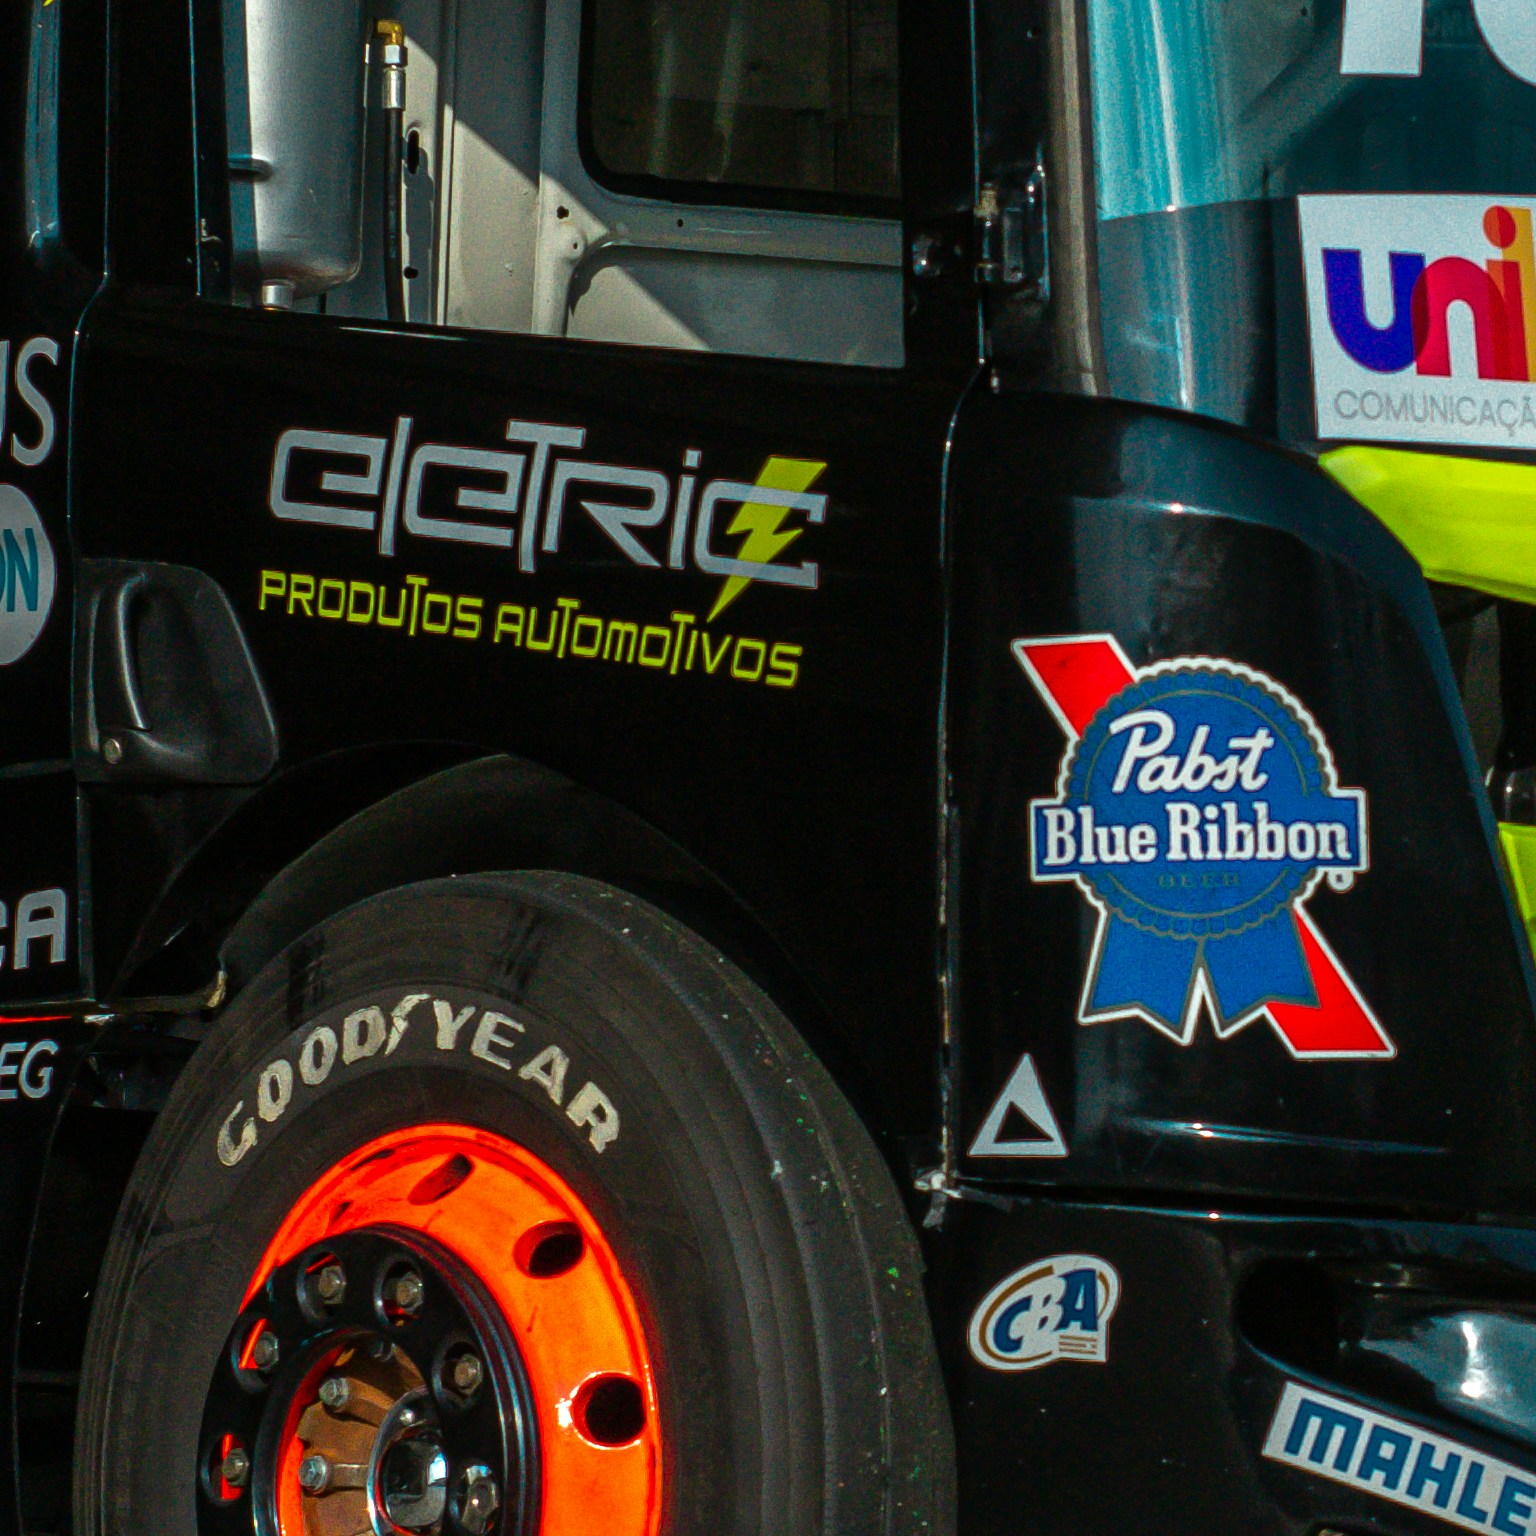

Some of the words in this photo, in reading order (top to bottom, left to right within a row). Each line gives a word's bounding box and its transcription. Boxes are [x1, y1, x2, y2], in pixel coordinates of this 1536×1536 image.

[258, 570, 483, 639] PRODUTOS
[493, 597, 804, 688] AUTOMOTIVOS
[1108, 709, 1275, 794] Pabst
[1041, 804, 1158, 866] Blue
[1164, 800, 1353, 863] Ribbon
[217, 993, 620, 1166] GOODYEAR
[993, 1267, 1099, 1354] CBA
